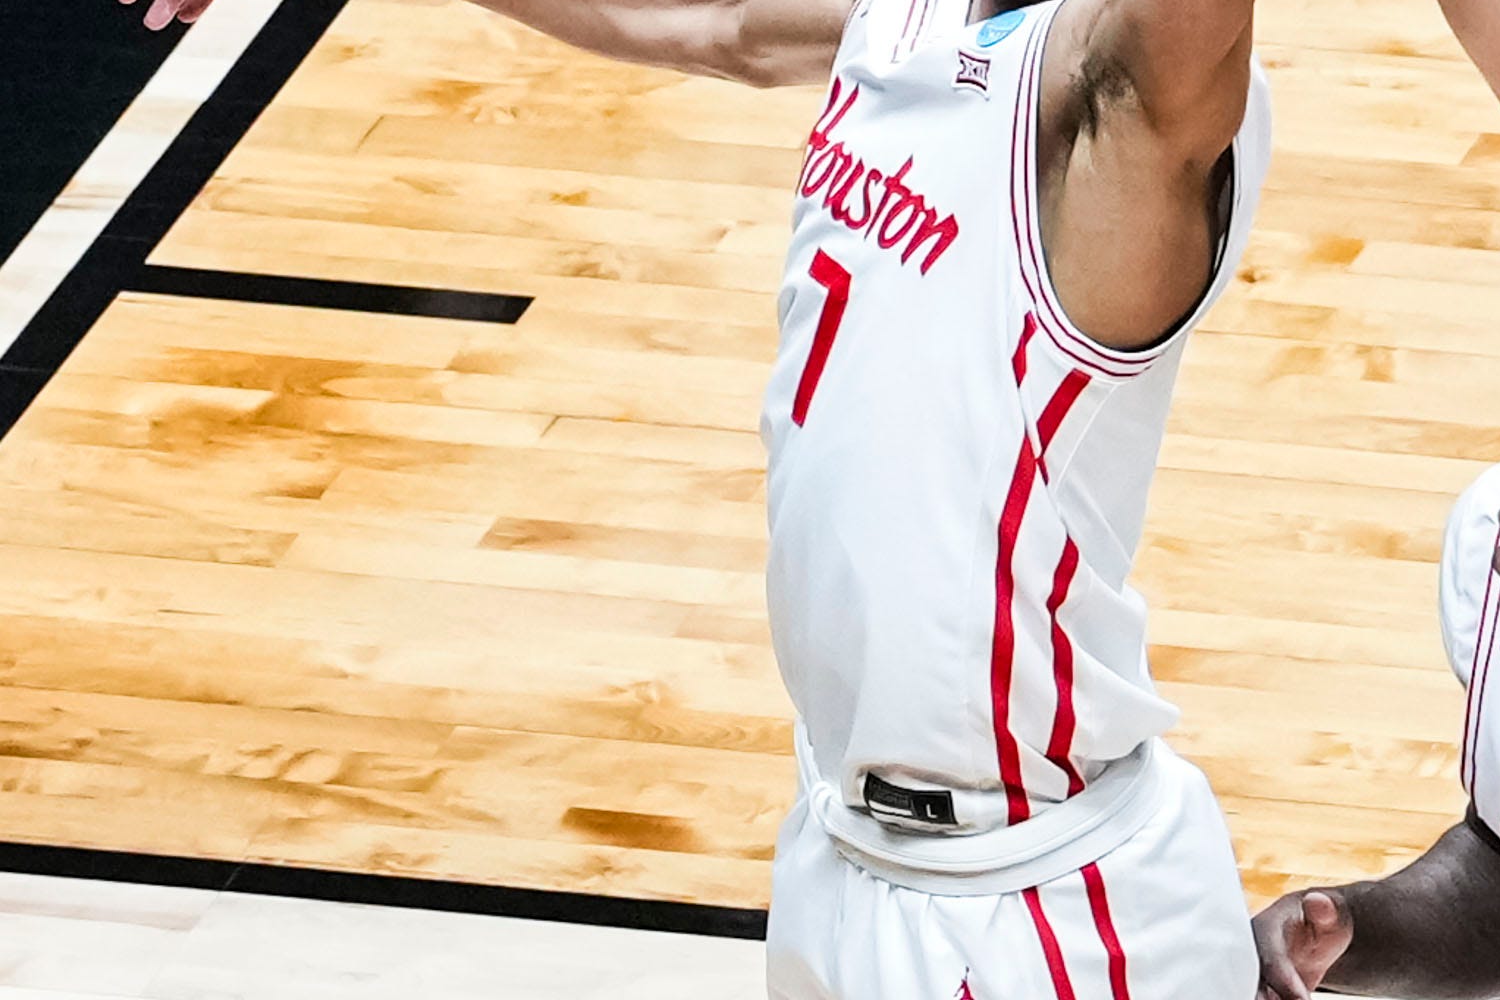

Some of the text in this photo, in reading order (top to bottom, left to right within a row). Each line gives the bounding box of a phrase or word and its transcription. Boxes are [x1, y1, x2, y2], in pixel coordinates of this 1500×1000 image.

[797, 75, 959, 277] Houston
[792, 247, 851, 428] 7
[925, 803, 939, 819] L
